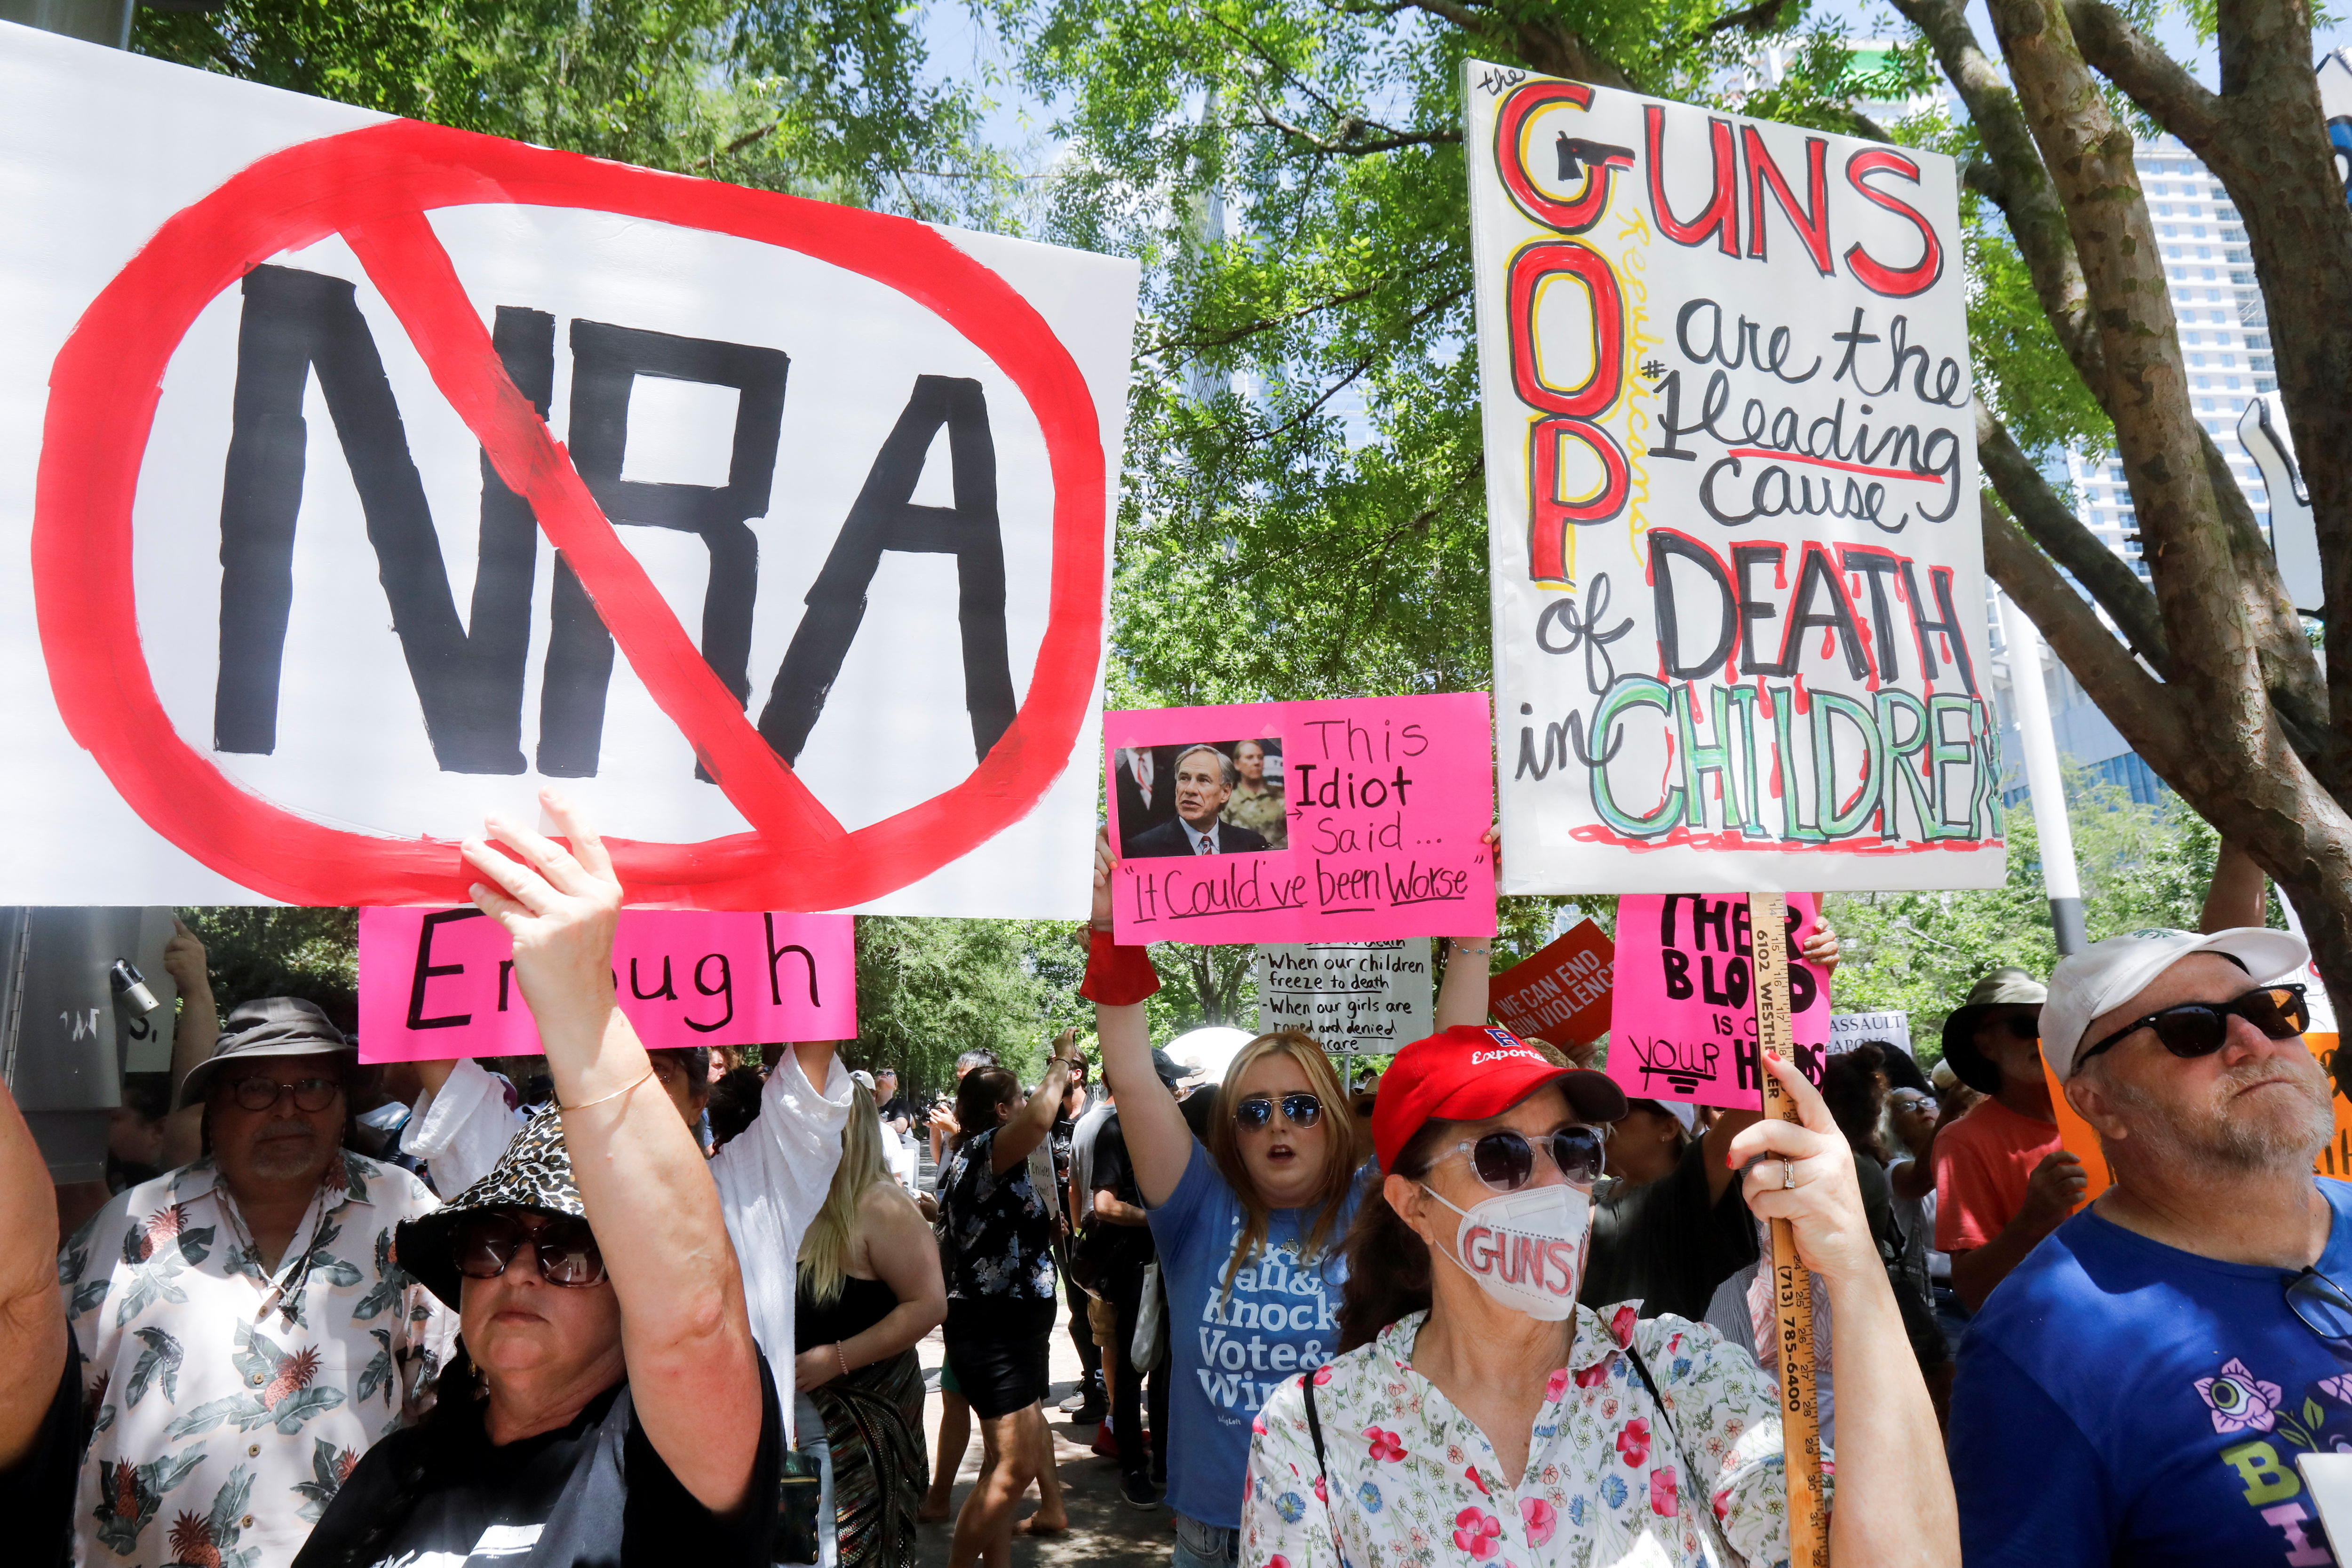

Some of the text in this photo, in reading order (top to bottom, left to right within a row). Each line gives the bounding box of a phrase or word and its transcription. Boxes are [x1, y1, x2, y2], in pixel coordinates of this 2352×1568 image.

[1477, 67, 1526, 96] the
[1494, 78, 1944, 299] GUNS
[1676, 298, 1972, 409] are the
[1661, 369, 1960, 524] leading
[214, 261, 1020, 782] NRA
[1699, 456, 1908, 533] cause
[1535, 528, 1977, 695] of DEATH
[1304, 718, 1429, 764] This
[1515, 673, 2003, 843] in CHILDREN
[1294, 764, 1413, 809] Idiot
[1164, 860, 1308, 918] Could've
[1317, 859, 1381, 906] been
[406, 908, 820, 1032] Eugh
[1268, 971, 1390, 989] freeze to death
[1324, 958, 1355, 970] our
[1359, 953, 1424, 973] children
[1495, 949, 1601, 1017] WE CAN END
[1662, 948, 1817, 1013] BLOD
[1756, 929, 1770, 972] 6102
[1317, 1002, 1342, 1014] our
[1347, 996, 1379, 1019] girls
[1385, 1001, 1412, 1014] are
[1319, 1018, 1344, 1035] and
[1346, 1019, 1398, 1035] denied
[1507, 1014, 1543, 1037] GUN
[1829, 1015, 1902, 1032] ASSAULT
[1463, 1225, 1573, 1297] GUNS
[1777, 1265, 1801, 1412] (713) 785-6400
